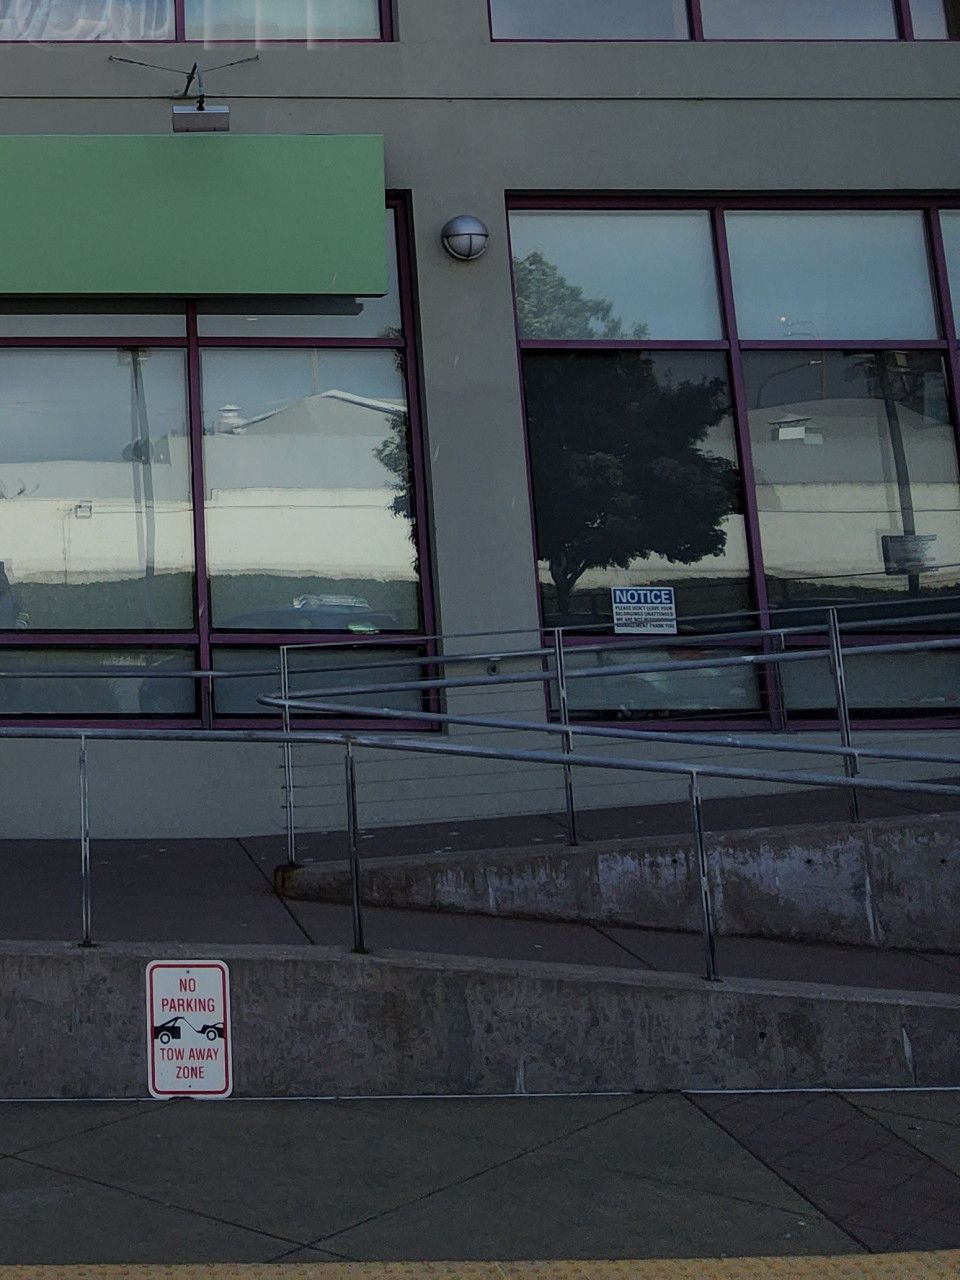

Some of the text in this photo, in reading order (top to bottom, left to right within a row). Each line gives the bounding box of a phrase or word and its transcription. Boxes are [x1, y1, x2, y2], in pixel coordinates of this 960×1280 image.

[615, 590, 671, 604] NOTICE
[179, 978, 196, 993] NO
[161, 998, 215, 1012] PARKING
[160, 1047, 219, 1061] TOW AWAY
[176, 1066, 204, 1079] ZONE
